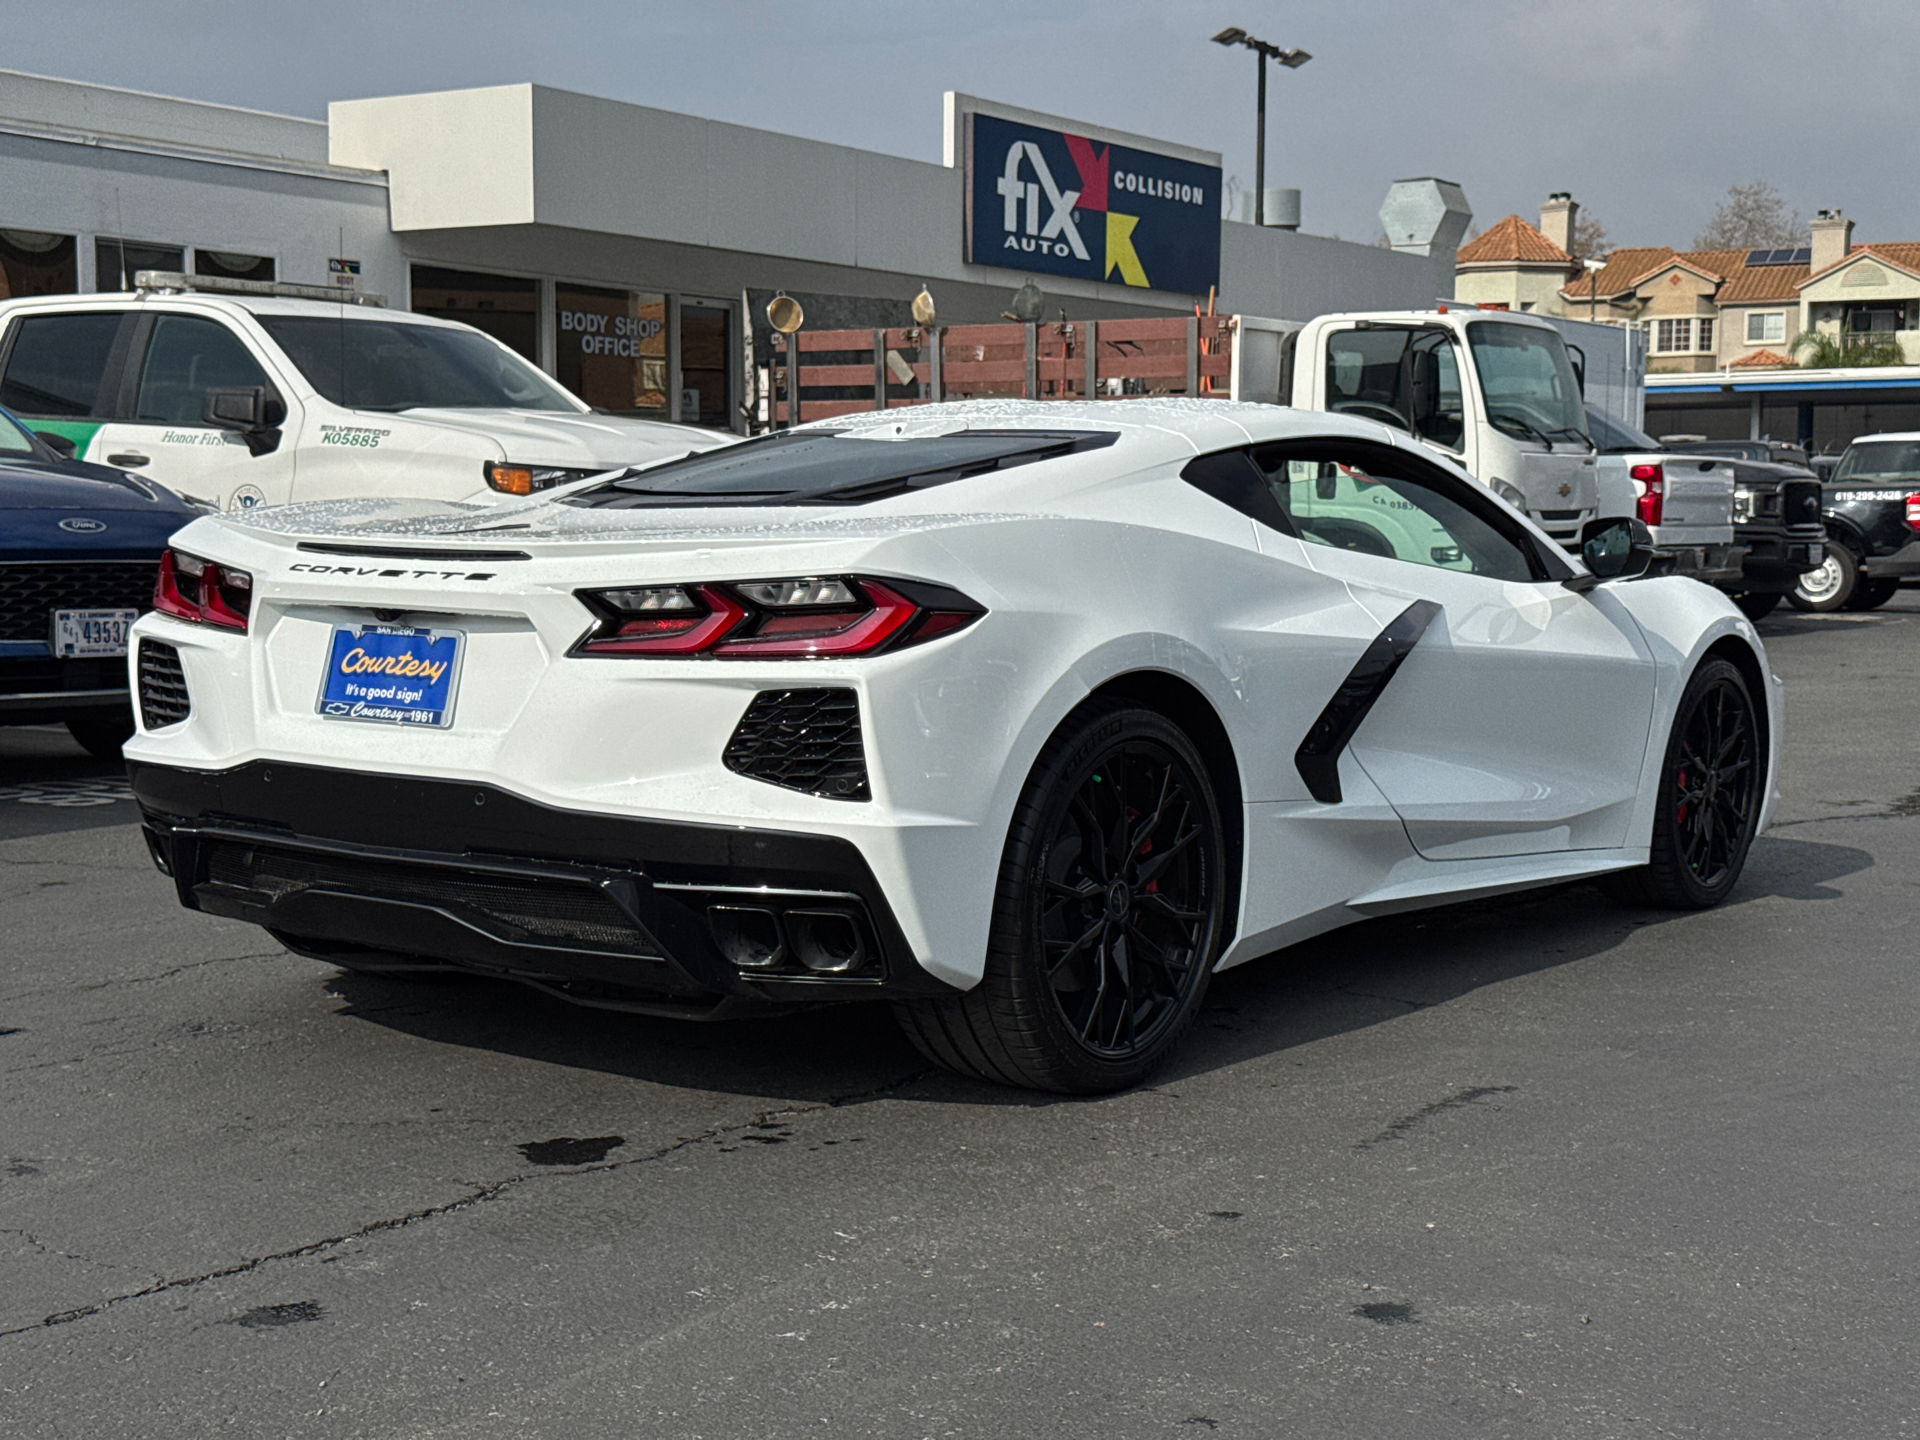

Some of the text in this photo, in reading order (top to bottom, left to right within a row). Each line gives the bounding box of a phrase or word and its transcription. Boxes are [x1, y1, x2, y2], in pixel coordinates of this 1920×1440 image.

[1114, 170, 1204, 205] COLLISION
[997, 140, 1091, 261] fix
[1003, 235, 1070, 258] AUTO
[561, 310, 661, 337] BODY SHOP
[581, 334, 641, 357] OFFICE
[160, 431, 199, 445] Honor
[1372, 495, 1387, 505] CA
[289, 563, 498, 581] CORVETTE
[376, 626, 415, 636] SAN DIEGO
[341, 648, 448, 685] Courtesy
[345, 683, 423, 704] It's a good sign!
[351, 701, 434, 724] Courtesy 1961
